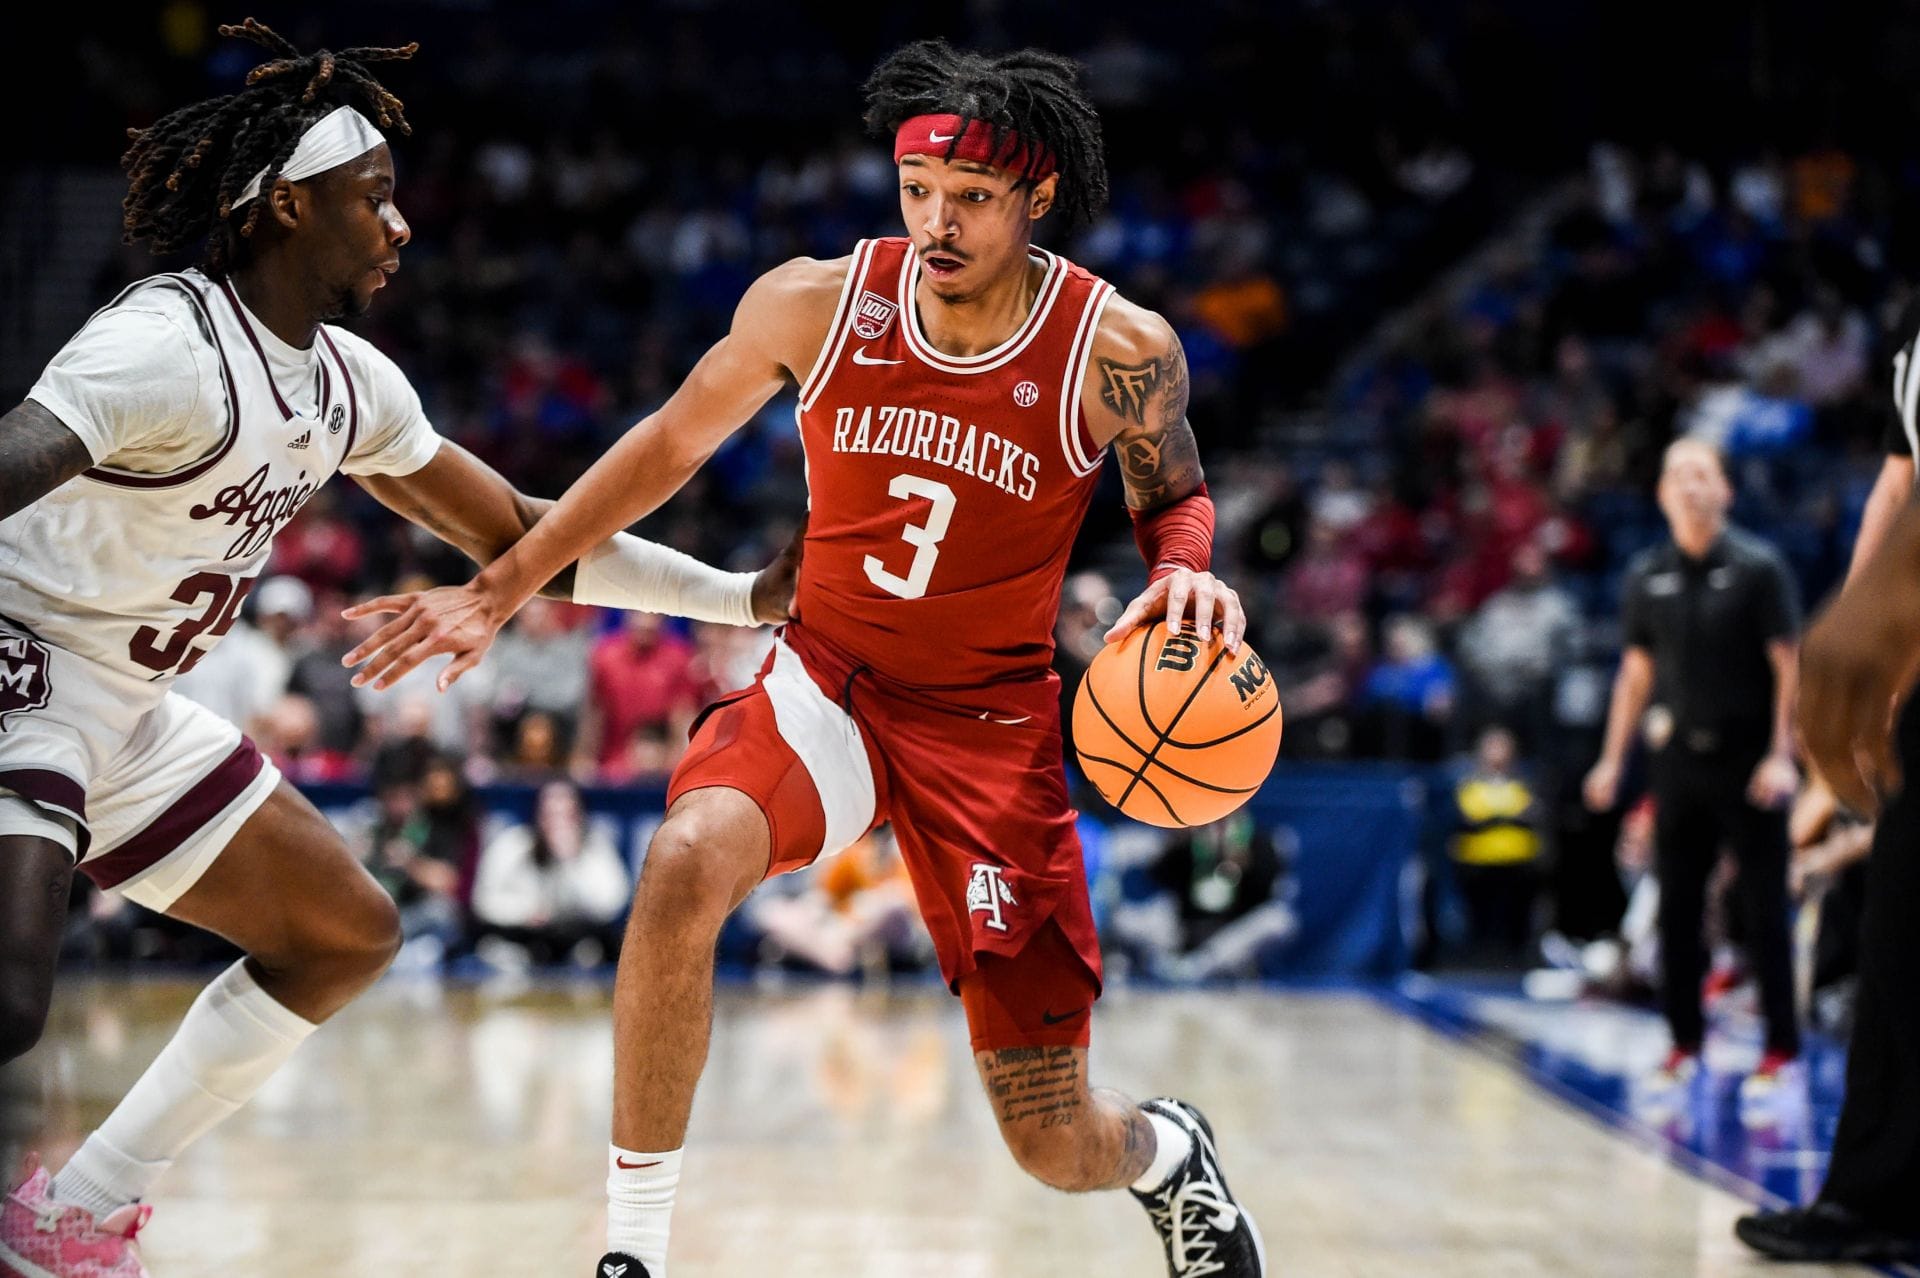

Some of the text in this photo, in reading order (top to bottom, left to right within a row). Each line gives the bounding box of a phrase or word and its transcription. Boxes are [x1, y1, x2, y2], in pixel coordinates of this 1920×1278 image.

[861, 299, 892, 321] 100
[1014, 383, 1037, 406] SEC
[832, 406, 1040, 502] RAZORBACKS
[862, 473, 957, 600] 3
